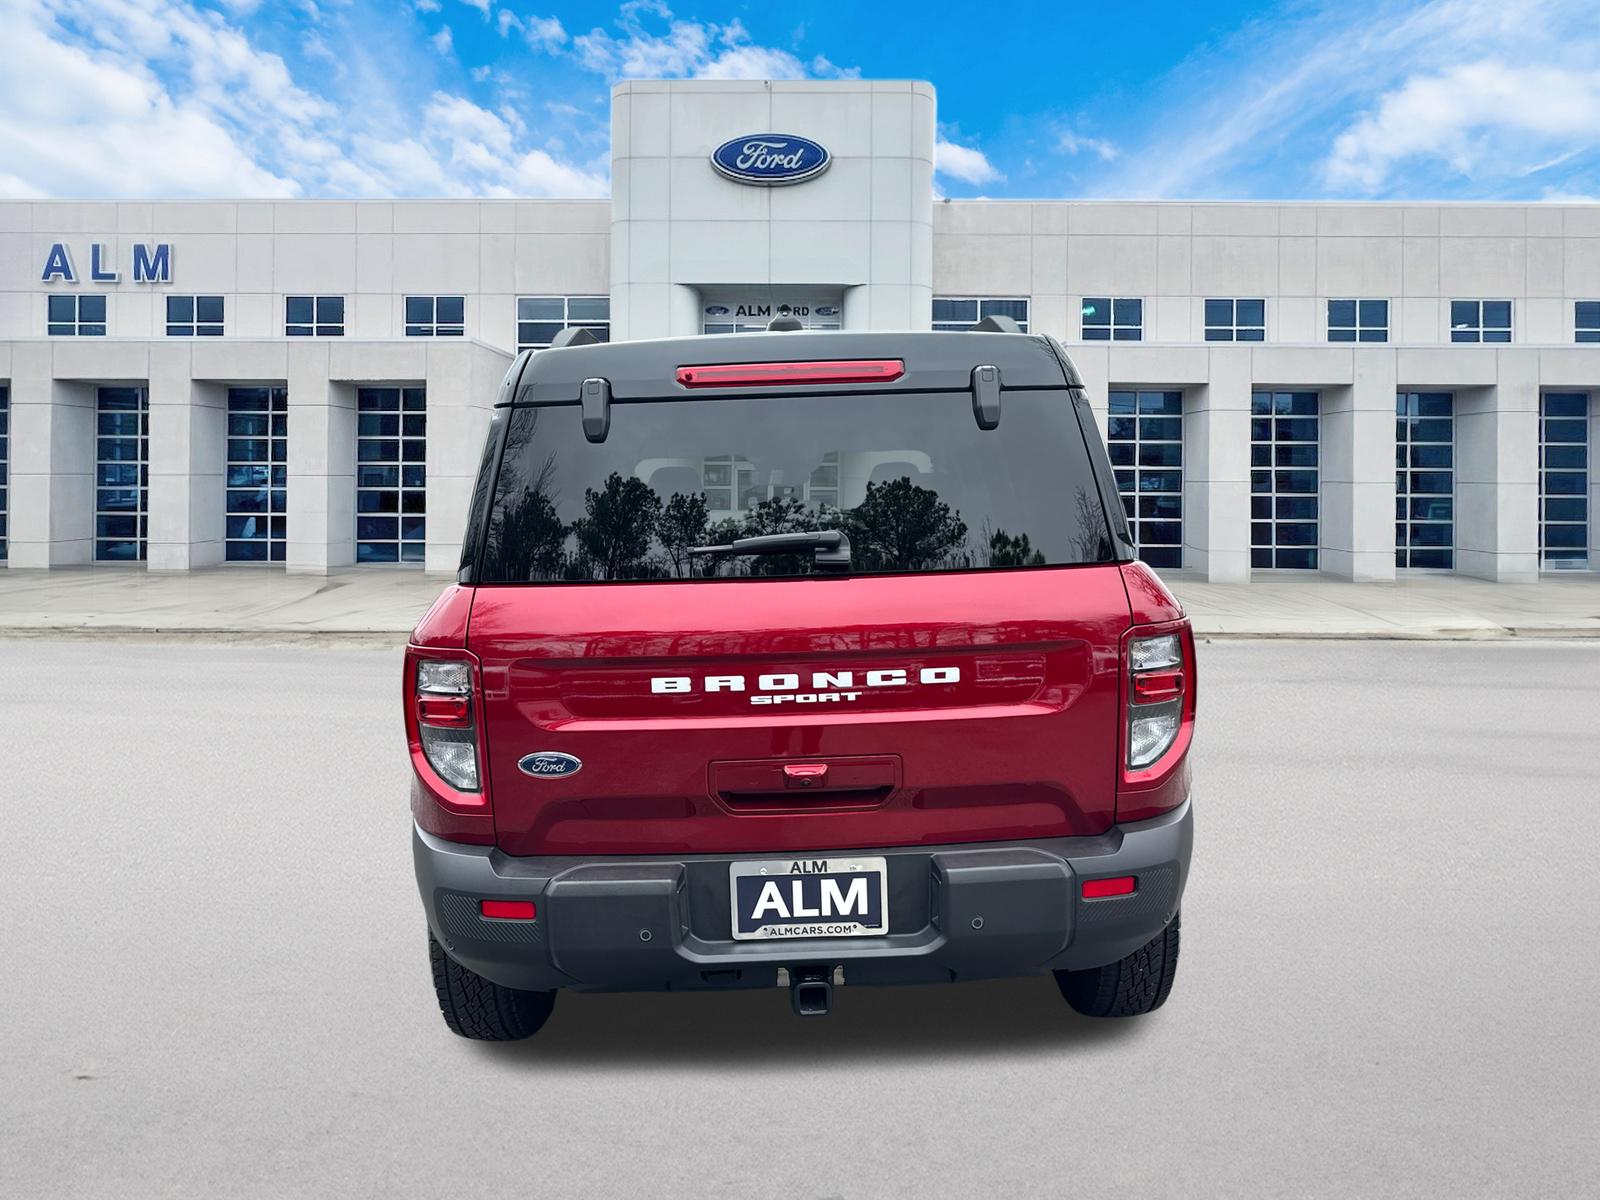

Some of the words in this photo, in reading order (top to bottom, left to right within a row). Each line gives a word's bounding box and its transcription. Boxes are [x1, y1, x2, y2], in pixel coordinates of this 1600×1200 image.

[736, 141, 804, 169] Ford
[41, 242, 171, 283] ALM
[735, 304, 771, 317] ALM
[776, 305, 810, 317] RD
[650, 666, 961, 694] BRONCO
[750, 691, 863, 705] SPORT
[532, 757, 567, 772] Ford
[790, 860, 828, 874] ALM
[750, 877, 869, 920] ALM
[769, 925, 853, 937] ALMCARS.COM
